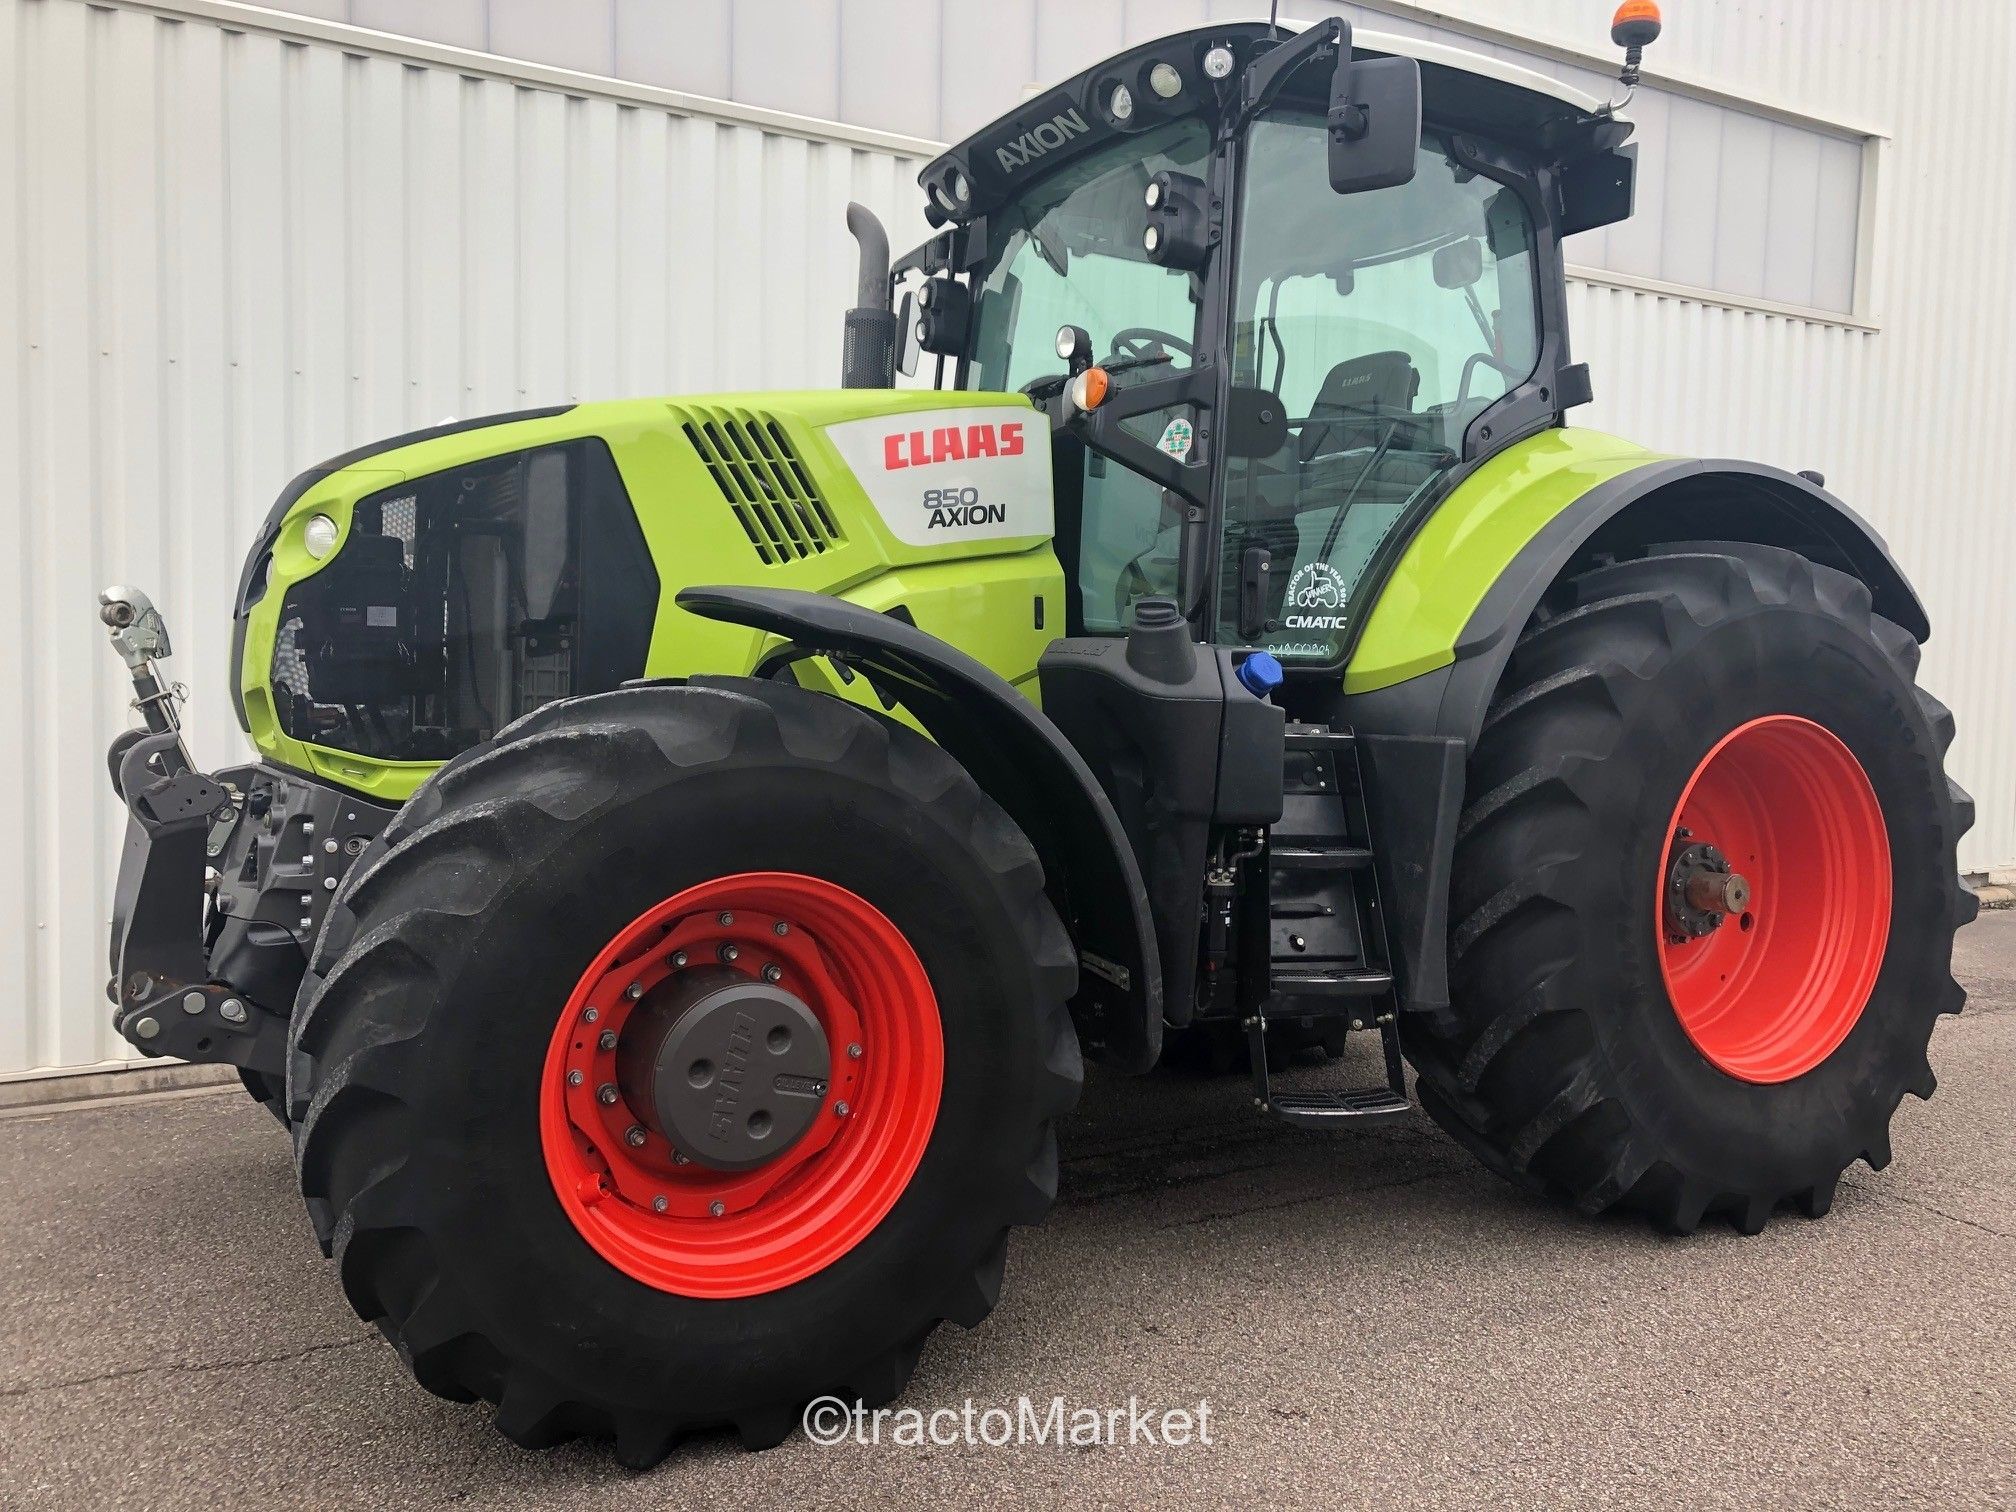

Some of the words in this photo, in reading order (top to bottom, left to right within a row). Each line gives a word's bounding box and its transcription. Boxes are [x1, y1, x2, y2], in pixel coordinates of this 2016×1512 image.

[994, 107, 1091, 174] AXION
[884, 423, 1024, 471] CLAAS
[923, 487, 979, 510] 850
[928, 503, 1006, 529] AXION
[1288, 569, 1305, 607] TRACTOR
[1304, 562, 1314, 572] OF
[1315, 562, 1329, 572] THE
[1329, 567, 1345, 587] YEAR
[1285, 615, 1348, 629] CMATIC
